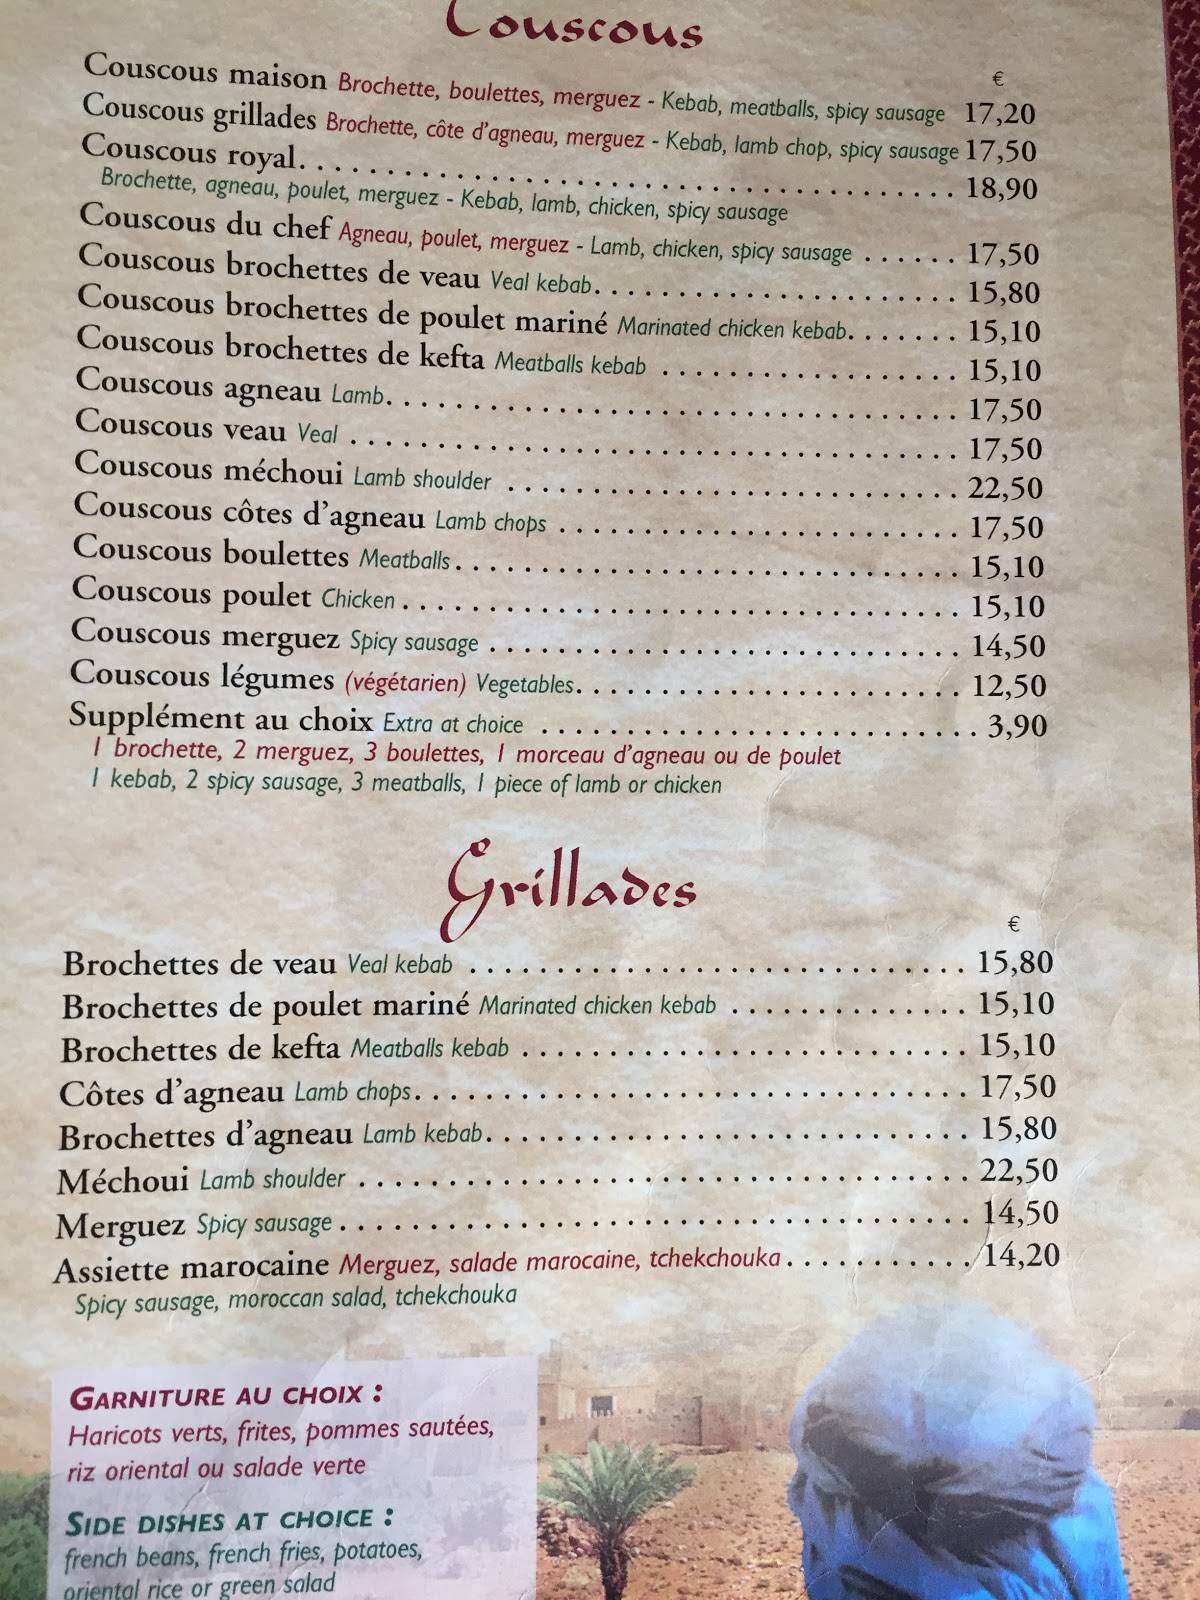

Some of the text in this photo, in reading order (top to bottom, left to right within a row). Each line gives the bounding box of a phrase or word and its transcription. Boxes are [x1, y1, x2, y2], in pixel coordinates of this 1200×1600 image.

[84, 52, 1035, 127] Couscous maison Brochette, boulettes, merguez Kebab, meatballs, spicy sausage 17,20
[992, 71, 1004, 86] €
[82, 132, 1037, 202] Couscous royal 18,90
[101, 166, 788, 226] Brochette, agneau, poulet, merguez Kebab, lamb, chicken, spicy sausage
[80, 202, 1039, 268] Couscous du chef Agneau, poulet, merguez Lamb, chicken, spicy sausage 17,50
[79, 242, 1040, 306] Couscous brochettes de veau Veal kebab 15,80
[77, 324, 1041, 384] Couscous brochettes de kefta Meatballs kebab 15,10
[76, 407, 1042, 463] Couscous veau Veal 17,50
[74, 491, 1043, 542] Couscous côtes d'agneau Lamb chops 17,50
[72, 575, 1045, 621] Couscous poulet Chicken 15,10
[70, 658, 1046, 700] Couscous légumes (végétarien) Vegetables 12,50
[69, 701, 1047, 740] Supplément au choix Extra at choice 3,90
[114, 737, 222, 762] brochette,
[233, 739, 246, 759] 2
[256, 746, 354, 766] merguez,
[364, 741, 377, 761] 3
[387, 742, 484, 766] boulettes,
[517, 749, 604, 763] morceau
[614, 744, 705, 770] d'agneau
[714, 751, 738, 764] ou
[747, 745, 770, 764] de
[779, 746, 841, 770] poulet
[440, 837, 697, 943] Grillades
[1008, 916, 1020, 932] €
[62, 949, 1053, 977] Brochettes de veau Veal kebab 15,80
[60, 1032, 1055, 1063] Brochettes de kefta Meatballs kebab 15,10
[60, 1074, 1056, 1113] Côtes d'agneau Lamb chops 17,50
[56, 1158, 1058, 1195] Méchoui Lamb shoulder 22,50
[52, 1241, 1061, 1284] Assiette marocaine Merguez, salade marocaine, tchekchouka 14,20
[75, 1283, 517, 1321] Spicy sausage, moroccan salad, tchekchouka
[69, 1414, 493, 1447] Haricots verts, frites, pommes sautées,
[68, 1455, 365, 1482] riz oriental ou salade verte
[65, 1540, 422, 1574] french beans, french fries, potatoes,
[65, 1571, 336, 1600] oriental rice or green salad
